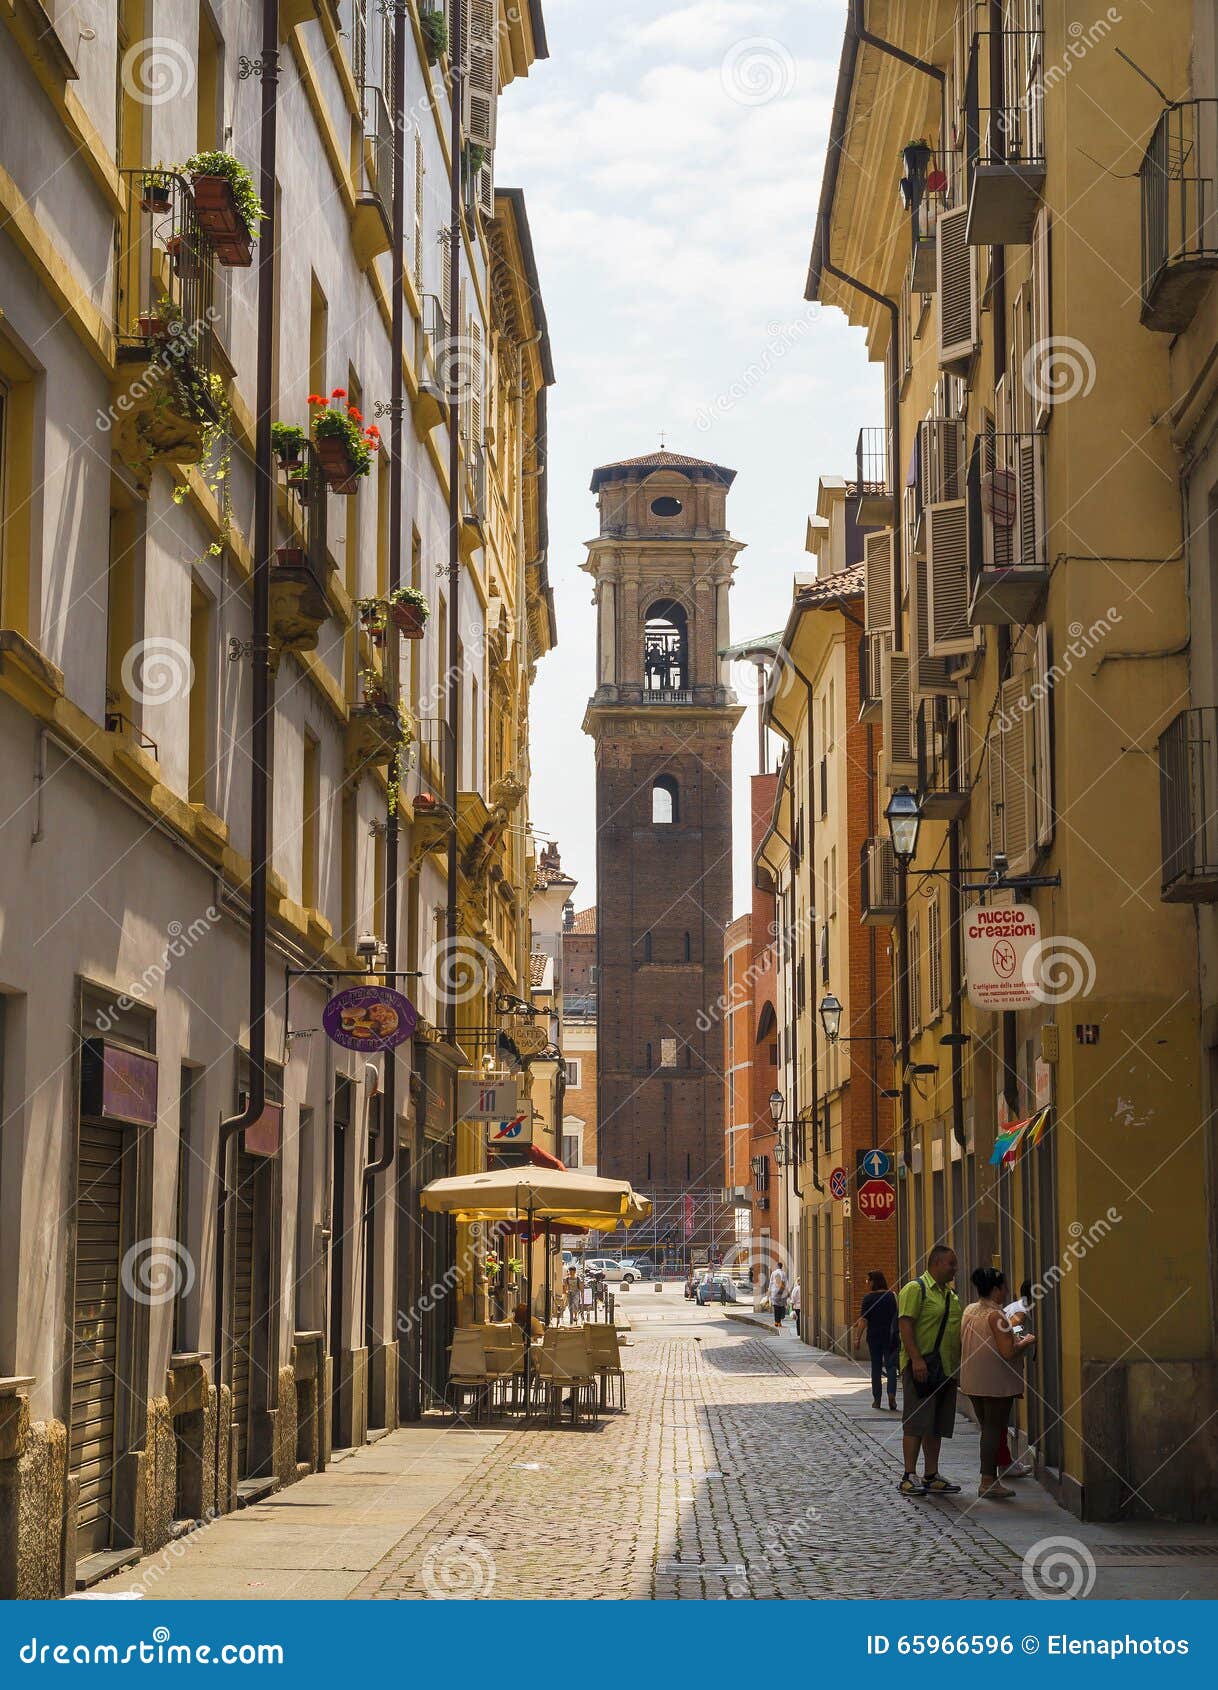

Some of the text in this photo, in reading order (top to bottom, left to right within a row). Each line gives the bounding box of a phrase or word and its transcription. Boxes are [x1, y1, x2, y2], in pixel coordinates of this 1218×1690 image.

[977, 911, 1024, 924] nuccio
[968, 924, 1036, 938] creazioni
[860, 1193, 894, 1209] STOP
